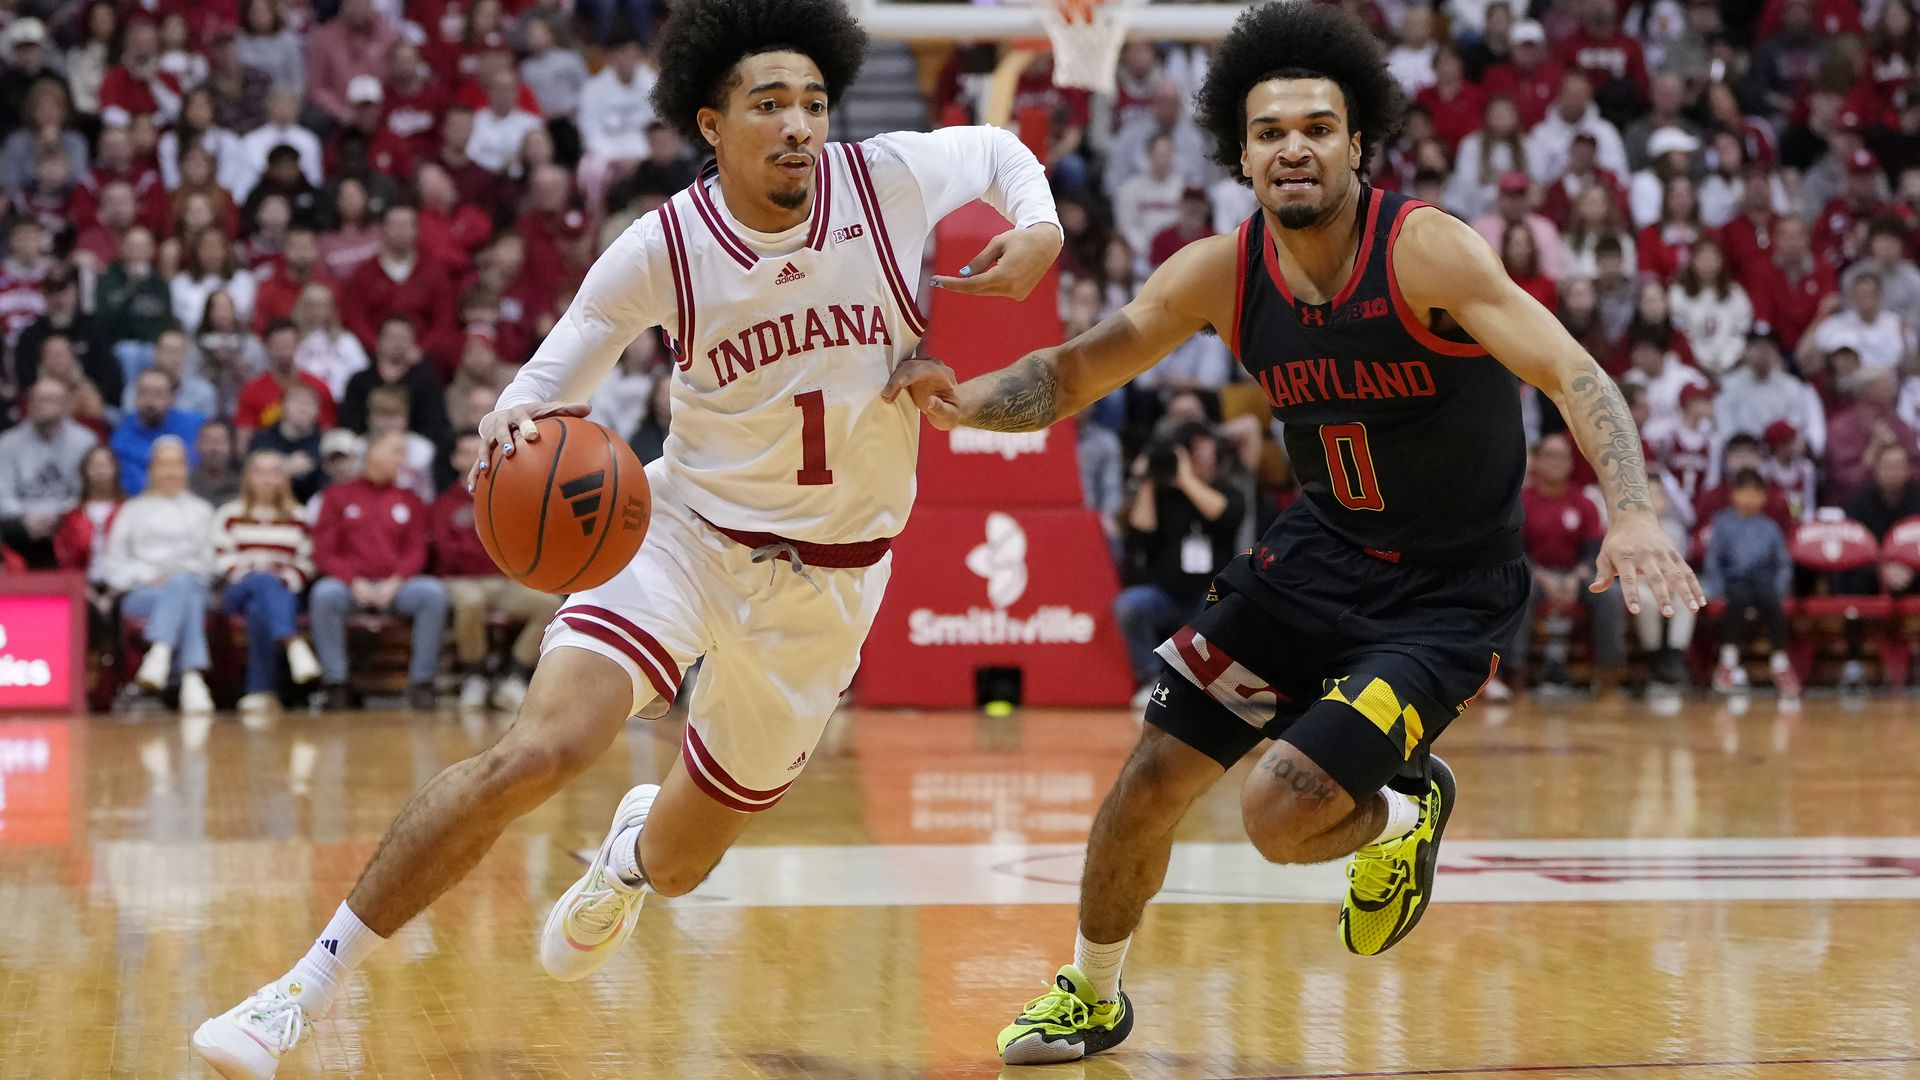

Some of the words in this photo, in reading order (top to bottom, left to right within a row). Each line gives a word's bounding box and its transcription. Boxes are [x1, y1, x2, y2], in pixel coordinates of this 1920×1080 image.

[775, 271, 806, 286] adidas
[707, 304, 892, 388] INDIANA
[793, 389, 833, 486] 1
[1319, 421, 1385, 511] 0
[908, 605, 1095, 646] Smithville
